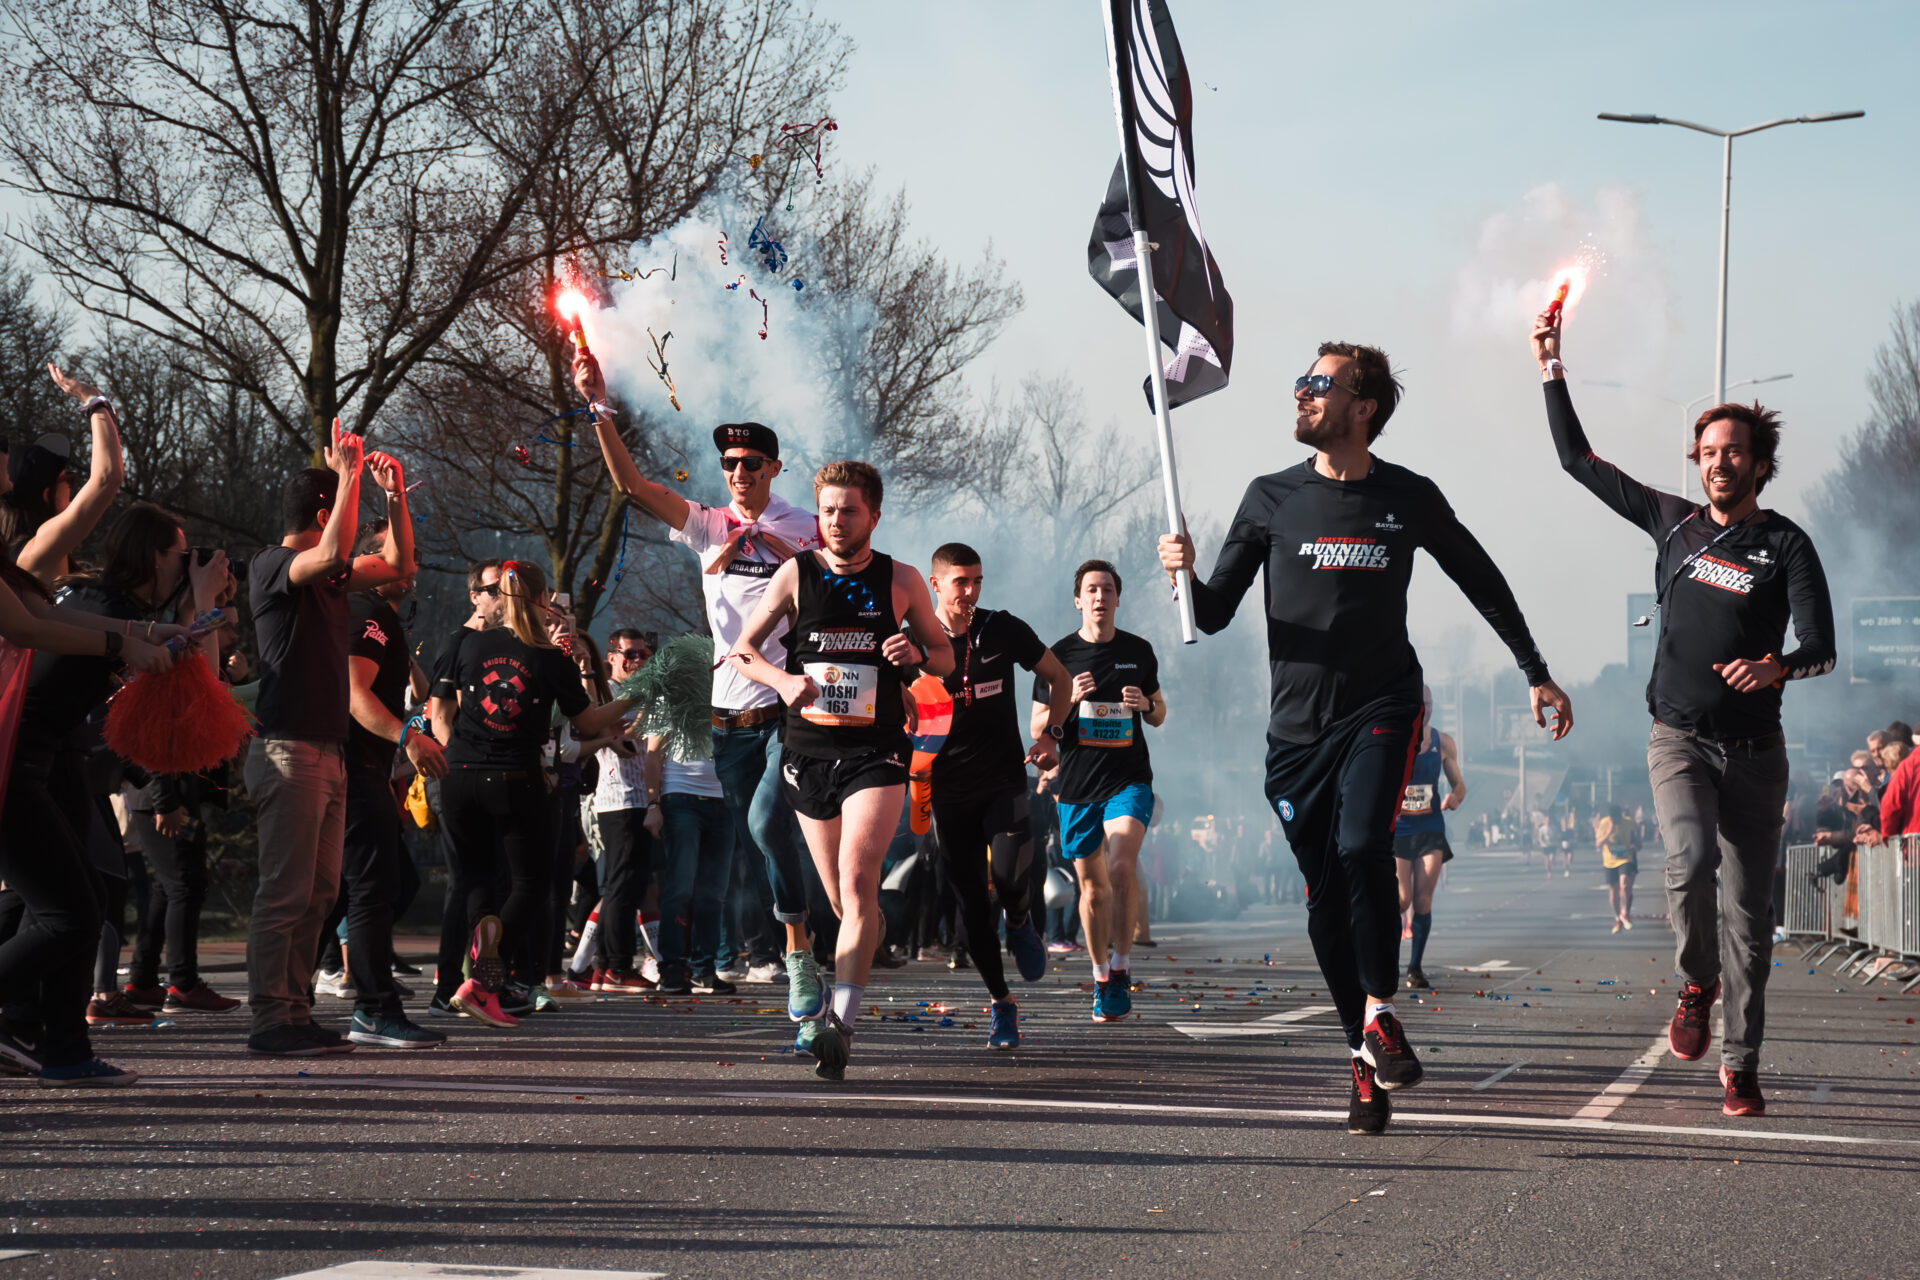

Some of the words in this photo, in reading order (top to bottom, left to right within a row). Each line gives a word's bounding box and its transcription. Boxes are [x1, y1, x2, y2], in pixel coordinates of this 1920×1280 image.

[727, 427, 750, 437] BTG
[1375, 522, 1404, 530] SAYSKY
[1315, 536, 1377, 544] AMSTERDAM
[1298, 542, 1387, 557] RUNNING
[1311, 554, 1390, 570] JUNKIES
[1700, 553, 1749, 573] AMSTERDAM
[729, 563, 774, 574] URBANEA
[1687, 566, 1754, 594] JUNKIES
[363, 619, 389, 647] Patta
[808, 632, 875, 642] RUNNING
[816, 641, 877, 652] JUNKIES
[842, 671, 859, 680] NN
[821, 684, 858, 699] YOSHI
[826, 700, 849, 714] 163
[1092, 719, 1122, 728] Deloitte
[1093, 729, 1120, 739] 41232
